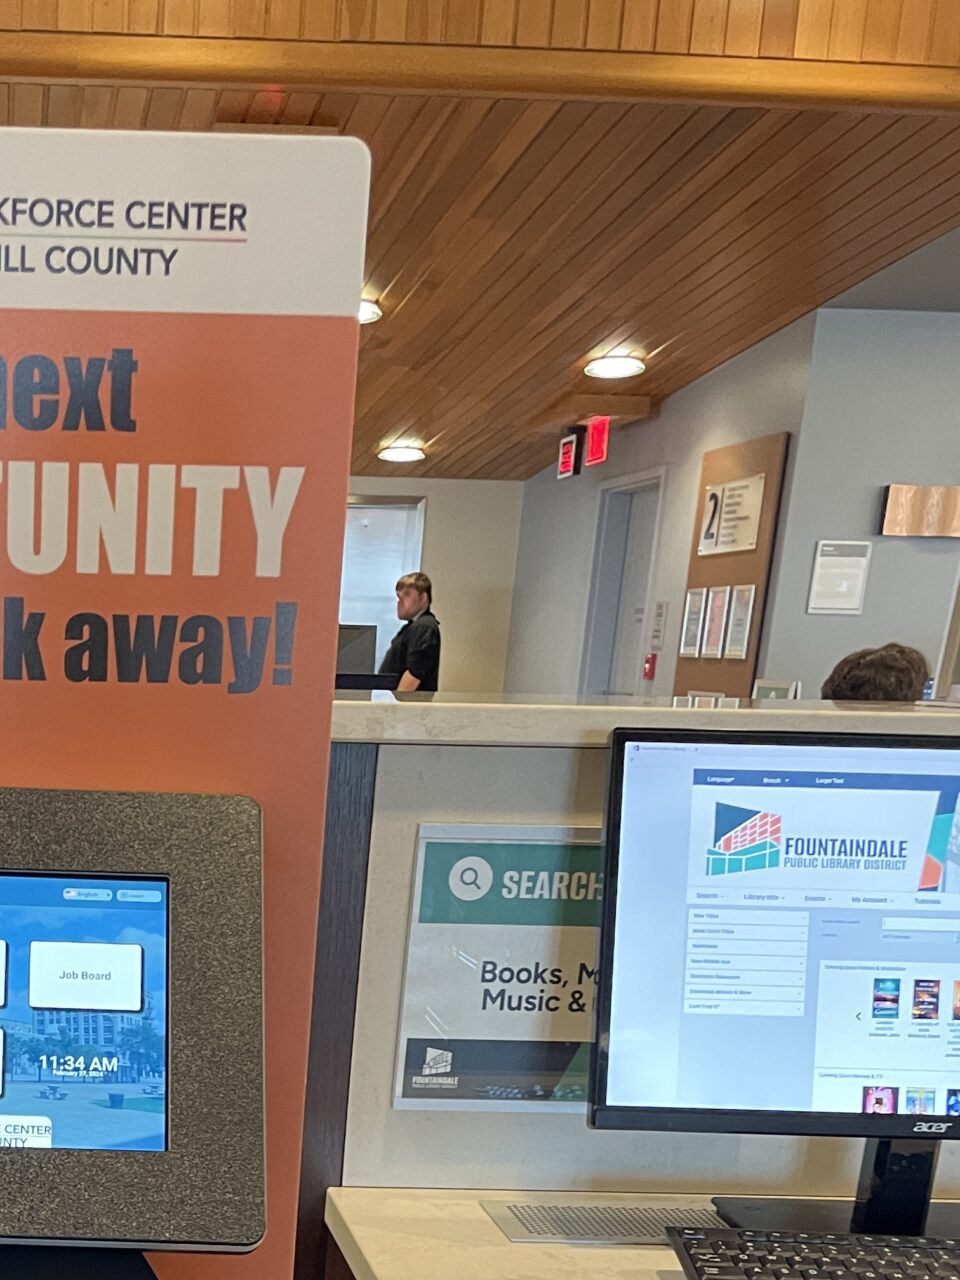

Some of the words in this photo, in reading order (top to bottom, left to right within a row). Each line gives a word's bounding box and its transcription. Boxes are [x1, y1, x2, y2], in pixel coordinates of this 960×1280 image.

[125, 201, 247, 232] CENTER
[44, 244, 178, 277] COUNTY
[704, 492, 719, 540] 2
[63, 601, 299, 695] away!
[785, 837, 908, 858] FOUNTAINDALE
[783, 857, 818, 868] PUBLIC
[821, 859, 861, 870] LIBRARY
[863, 860, 907, 872] DISTRICT
[59, 970, 79, 980] Job
[81, 971, 111, 981] Board
[480, 960, 569, 988] Books,
[481, 988, 561, 1012] Music
[568, 989, 587, 1013] &
[39, 1055, 86, 1070] 11:34
[89, 1056, 118, 1072] AM
[5, 1124, 51, 1136] CENTER
[913, 1122, 952, 1133] acer
